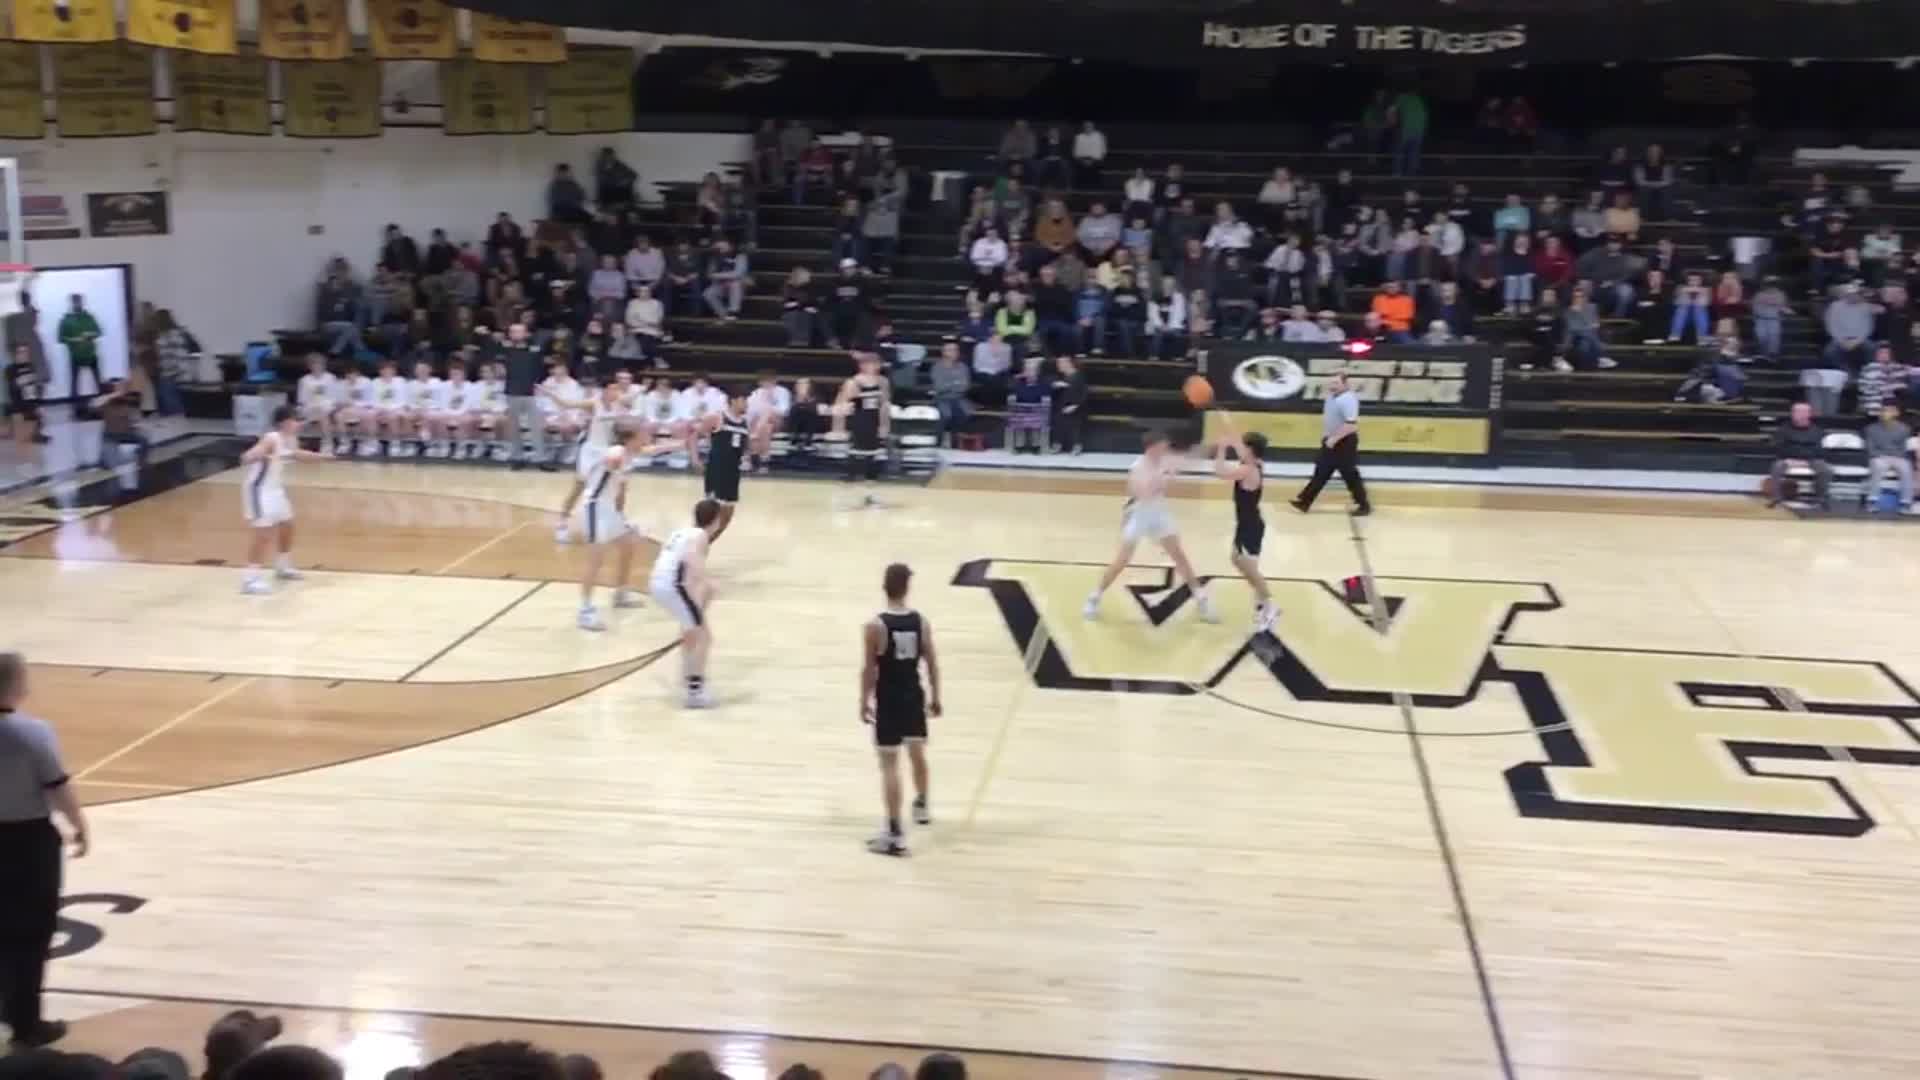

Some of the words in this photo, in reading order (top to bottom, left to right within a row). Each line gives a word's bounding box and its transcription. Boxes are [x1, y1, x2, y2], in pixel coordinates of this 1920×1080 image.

[1202, 22, 1292, 49] HOME
[1294, 23, 1338, 49] OF
[1354, 25, 1415, 50] THE
[1418, 25, 1527, 54] TIGERS
